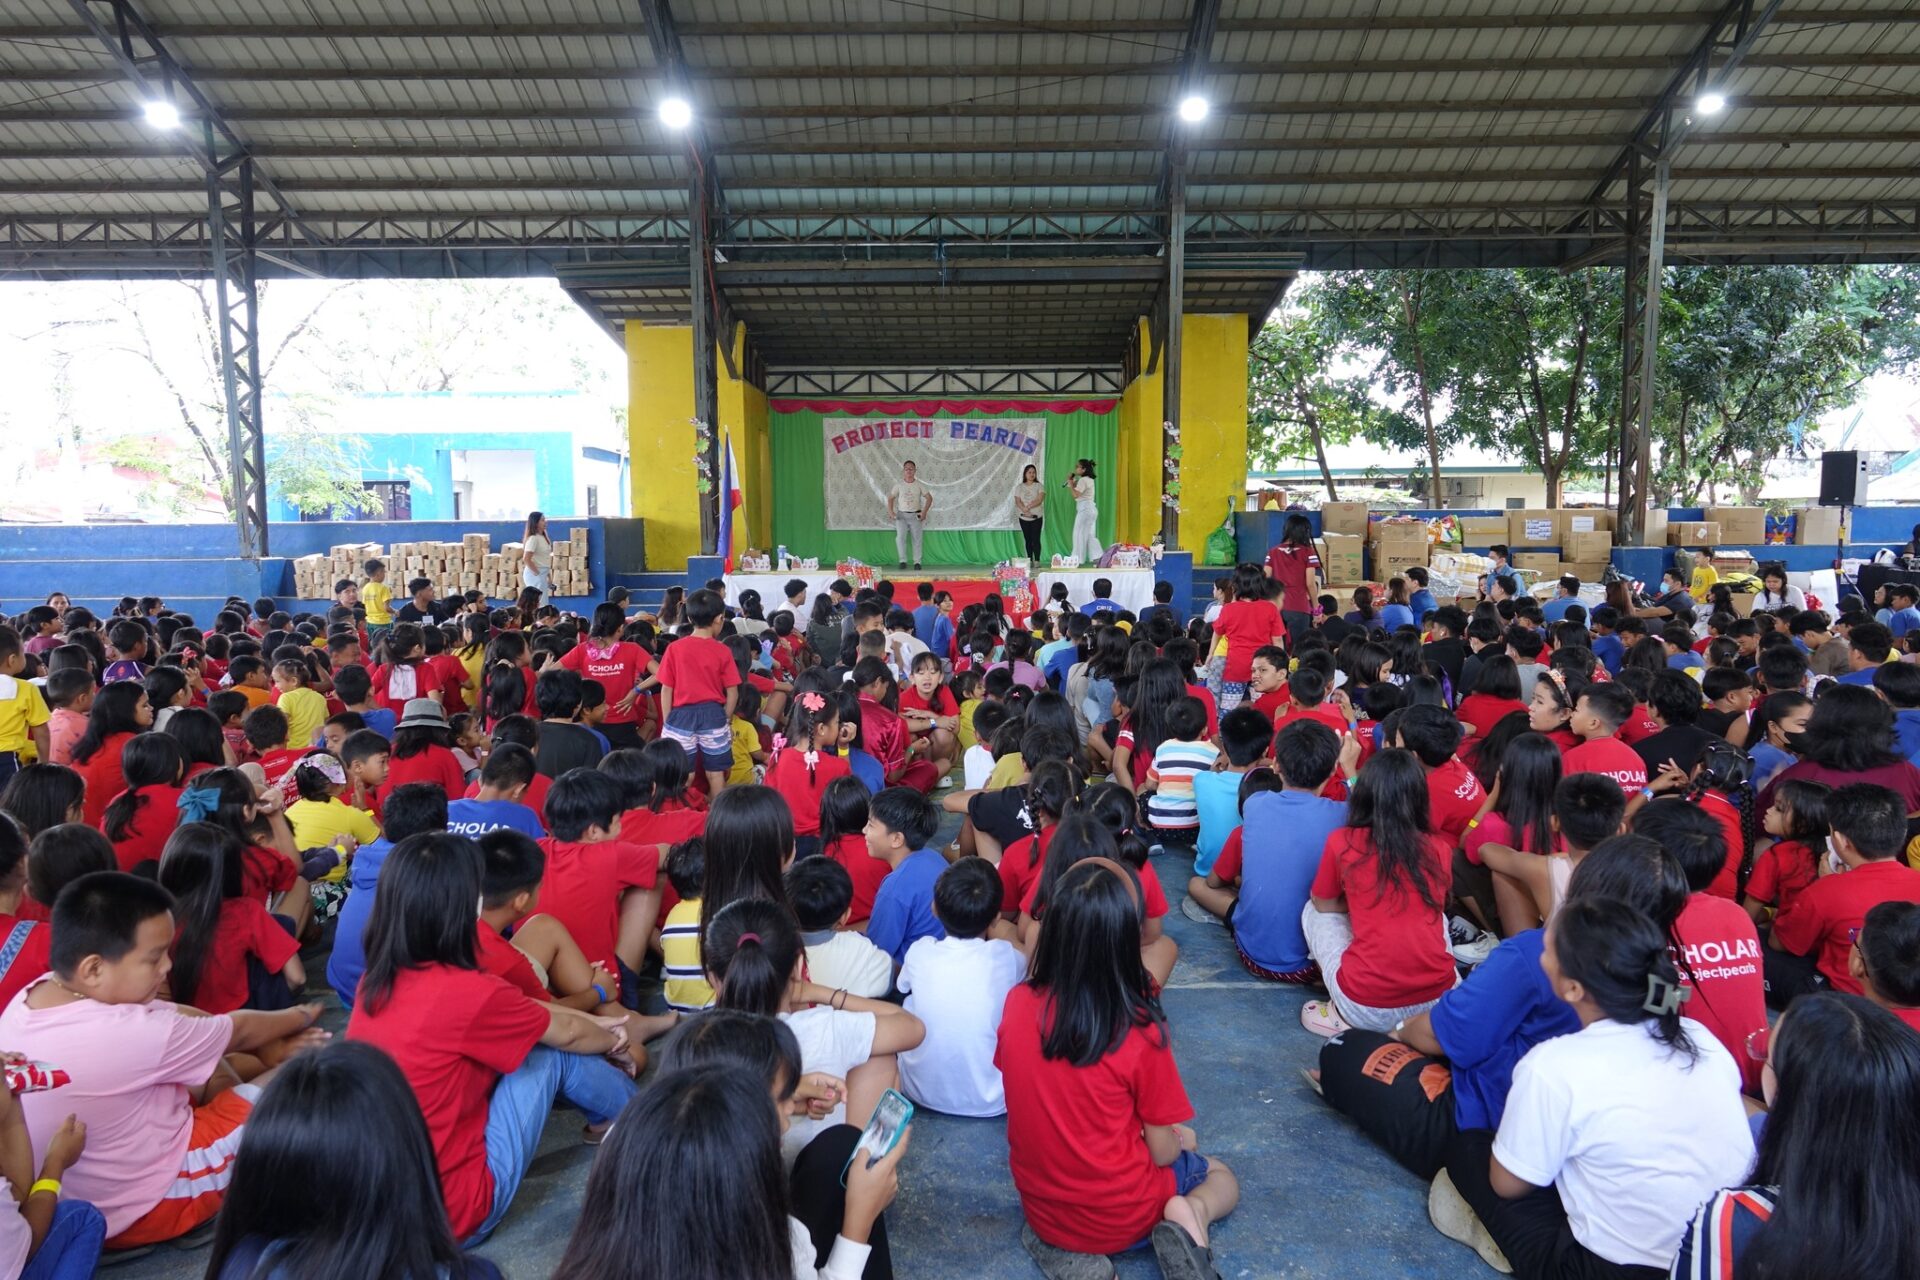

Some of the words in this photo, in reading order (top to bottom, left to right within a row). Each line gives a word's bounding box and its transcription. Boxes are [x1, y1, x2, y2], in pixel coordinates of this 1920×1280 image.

[831, 421, 933, 454] PROJECT
[950, 421, 1038, 456] PEARLS
[588, 663, 624, 672] SCHOLAR
[1667, 938, 1760, 965] HOLAR
